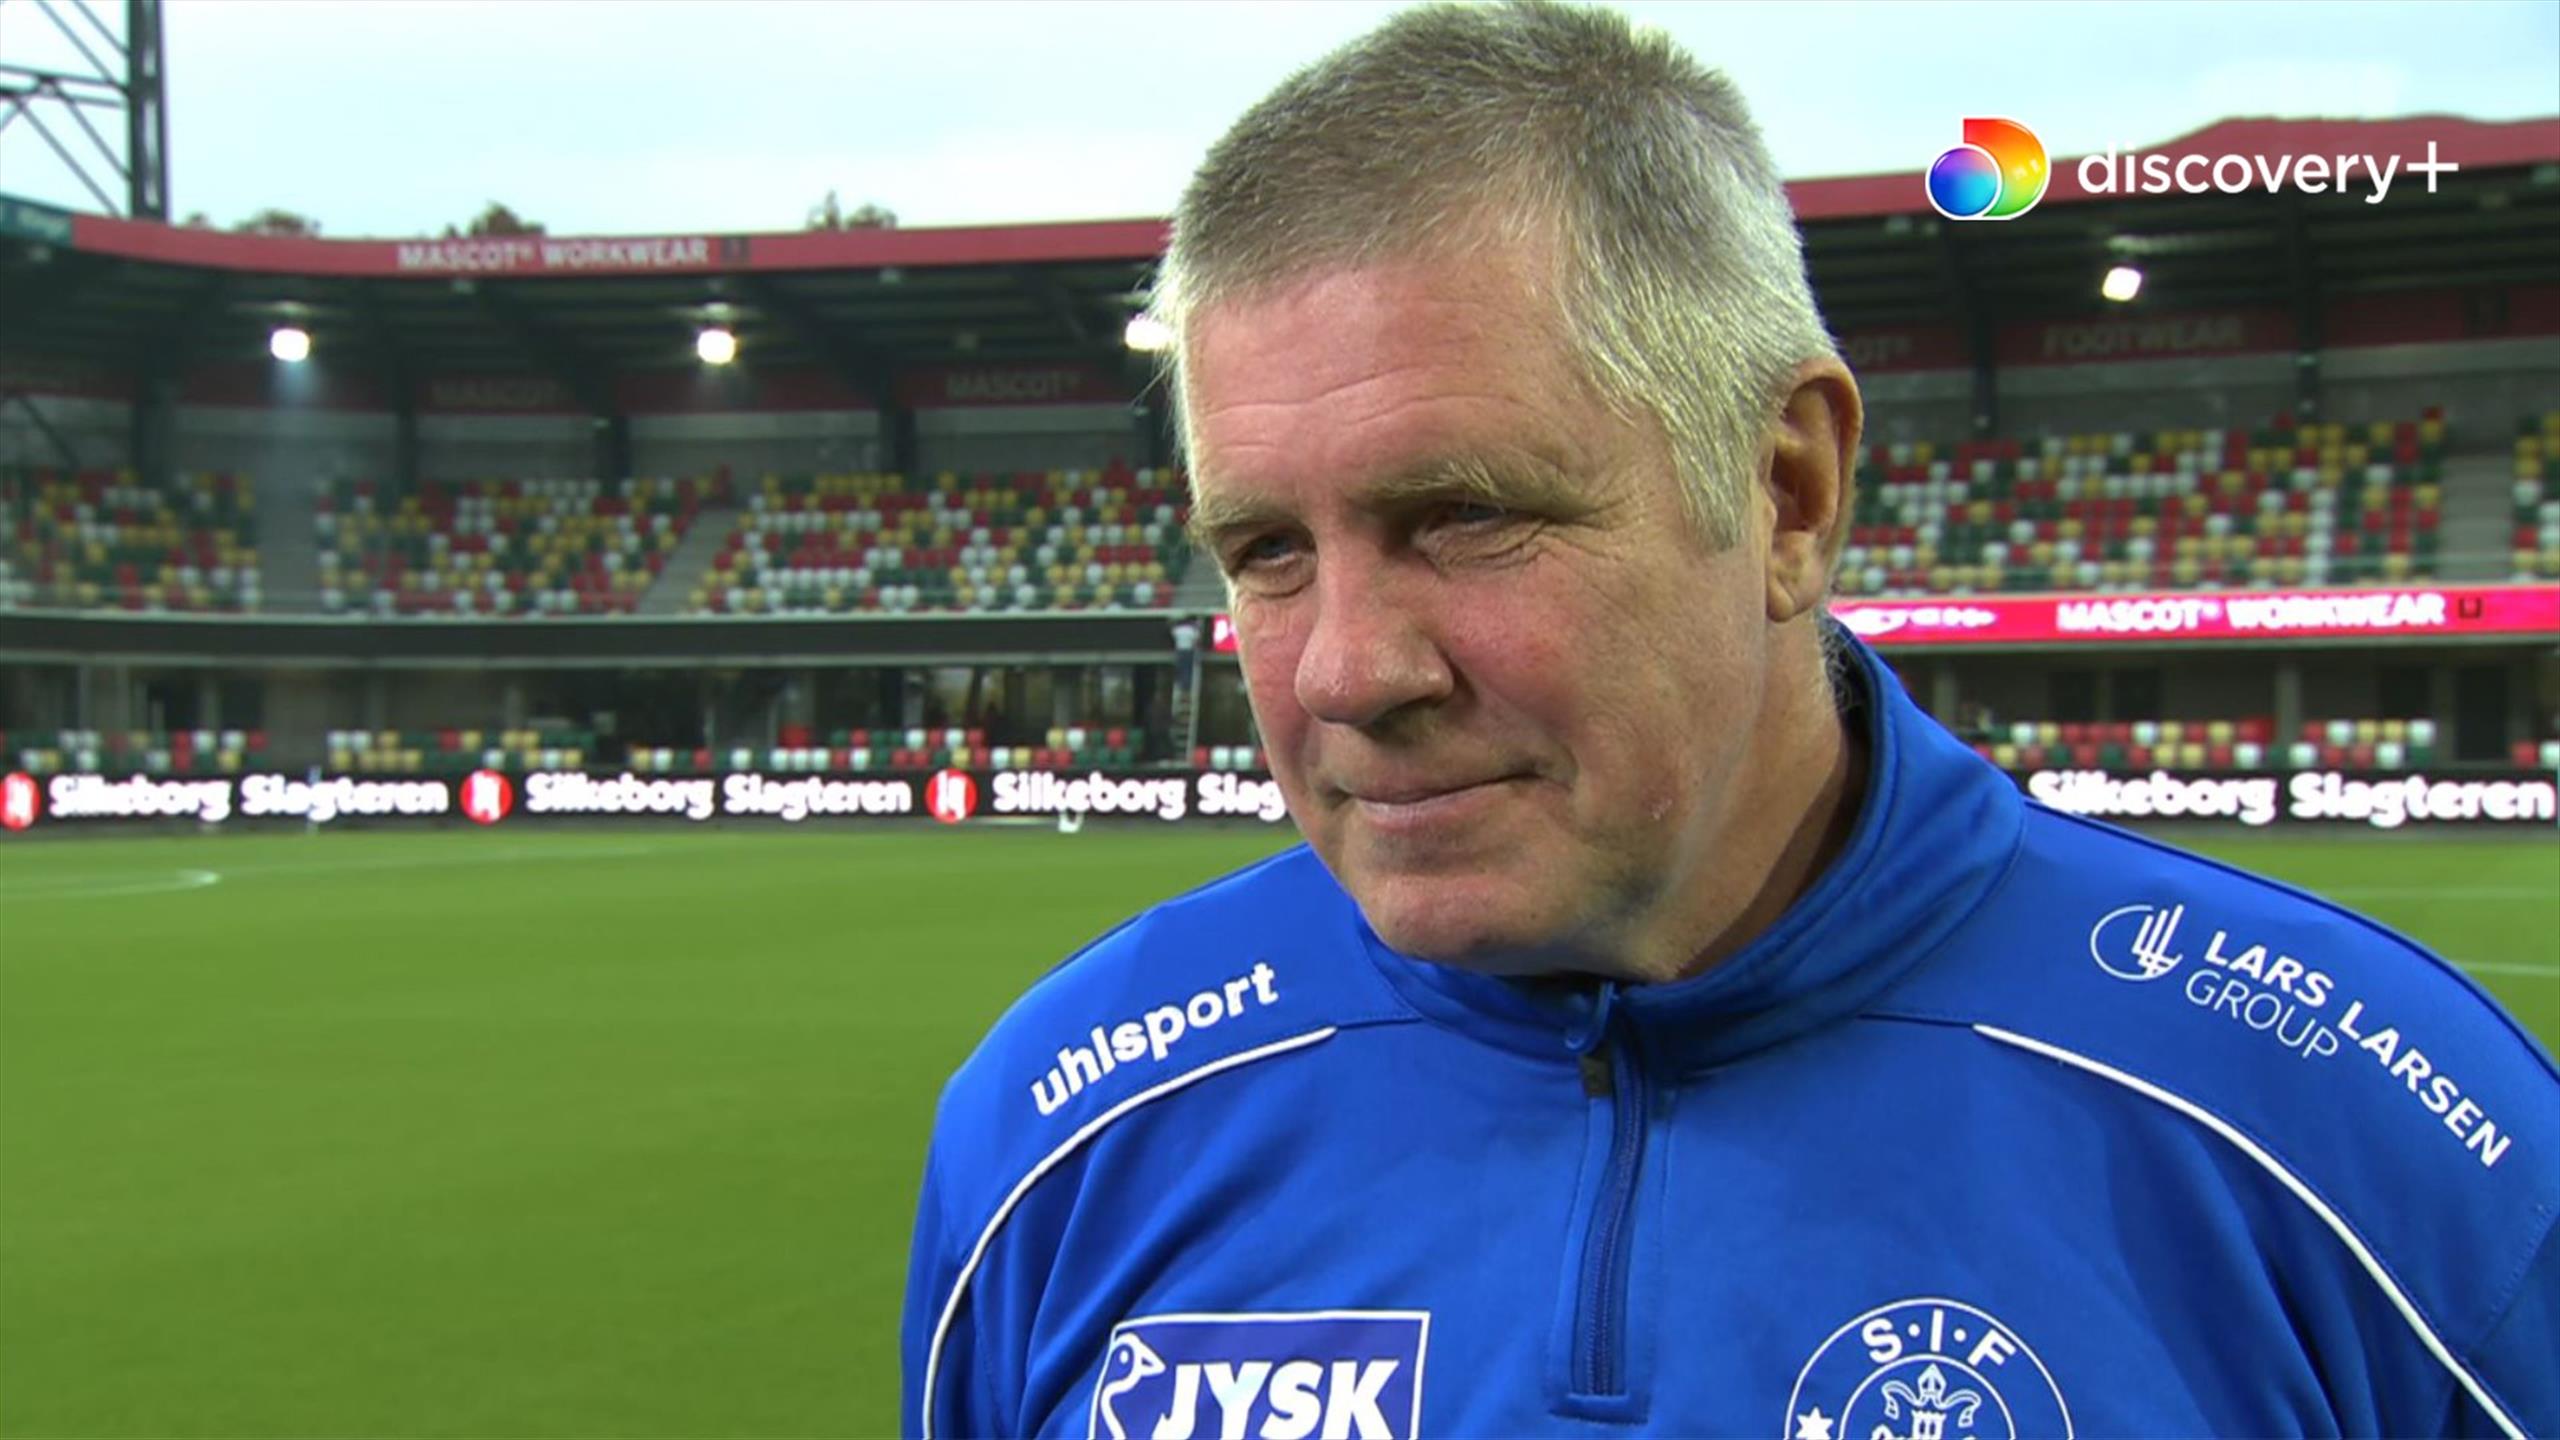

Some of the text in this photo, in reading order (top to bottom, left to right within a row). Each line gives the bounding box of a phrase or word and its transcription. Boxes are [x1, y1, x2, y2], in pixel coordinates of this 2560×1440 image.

[540, 237, 709, 268] WORKWEAR
[2043, 315, 2244, 357] FOOTWEAR
[2226, 594, 2446, 628] WORKWEAR
[49, 772, 232, 822] Silkeborg
[241, 772, 449, 822] Slagteren
[525, 771, 714, 820] Silkeborg
[723, 772, 912, 820] Slagteren
[992, 770, 1187, 820] Silkeborg
[1197, 773, 1287, 822] Slag
[2029, 769, 2556, 828] Silkeborg Slagteren
[1029, 962, 1279, 1117] uhlsport
[2184, 968, 2339, 1060] GROUP
[2203, 930, 2335, 1008] LARS
[2336, 1000, 2512, 1169] LARSEN
[1151, 1360, 1400, 1440] JYSK
